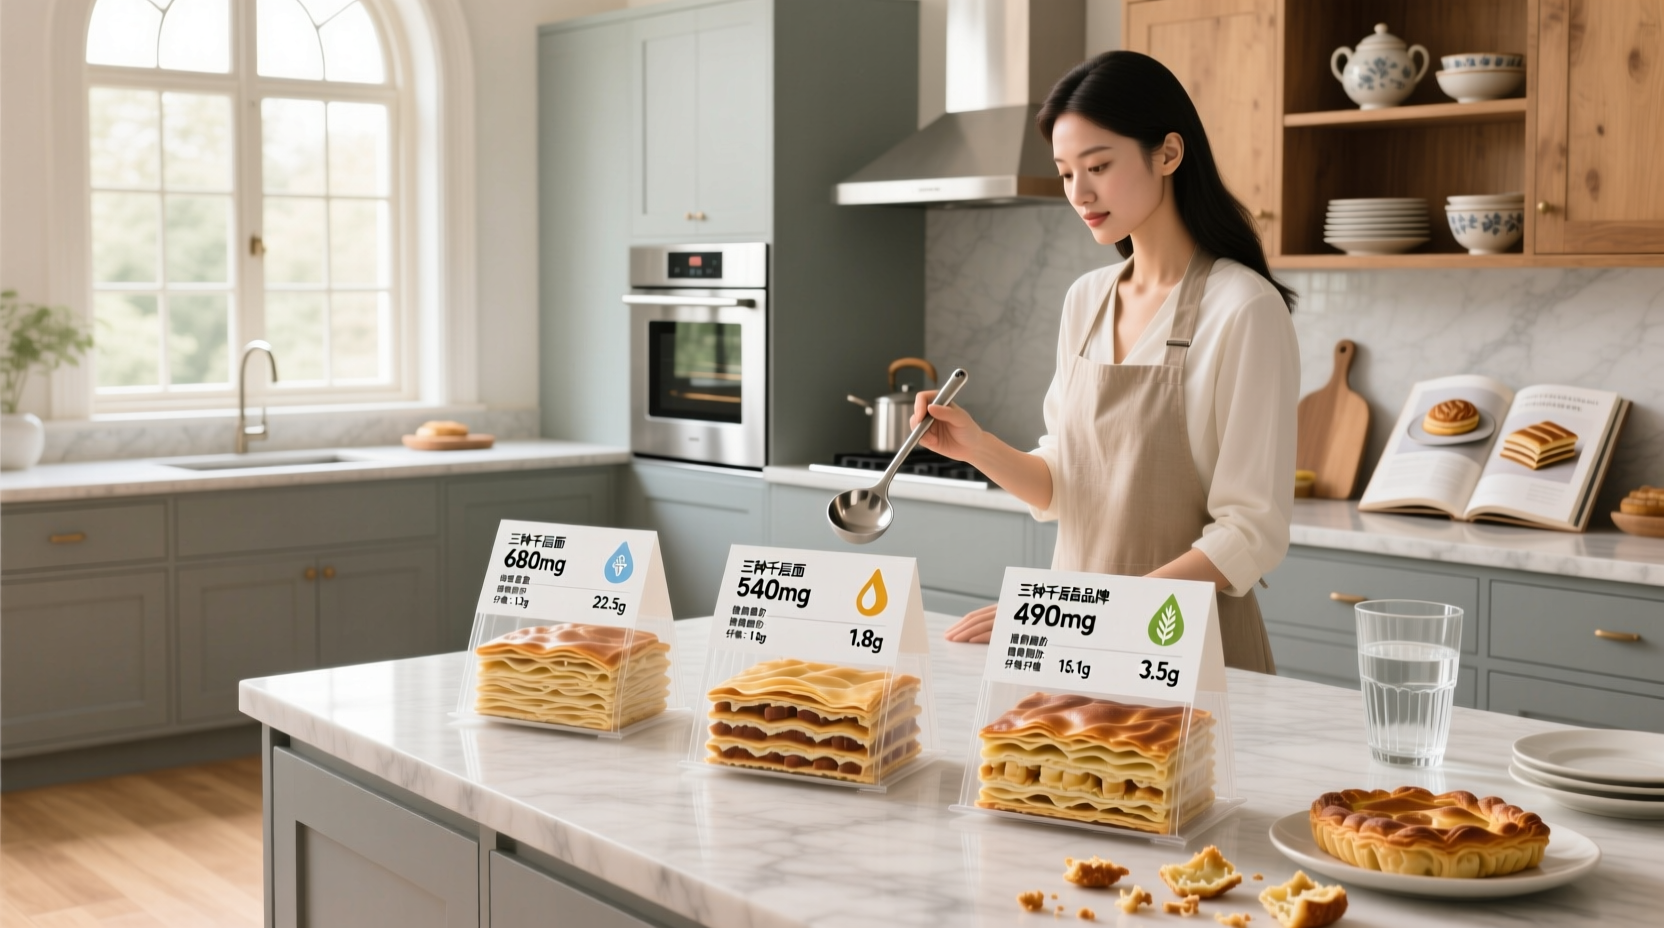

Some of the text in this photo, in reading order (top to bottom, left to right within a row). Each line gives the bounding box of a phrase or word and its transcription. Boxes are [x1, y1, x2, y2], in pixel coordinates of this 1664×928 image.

[504, 548, 567, 577] 680mg
[592, 595, 627, 616] 22.5g
[736, 577, 812, 608] 540mg
[1013, 602, 1097, 636] 490mg
[849, 628, 884, 654] 1.8g
[1138, 659, 1180, 688] 3.5g
